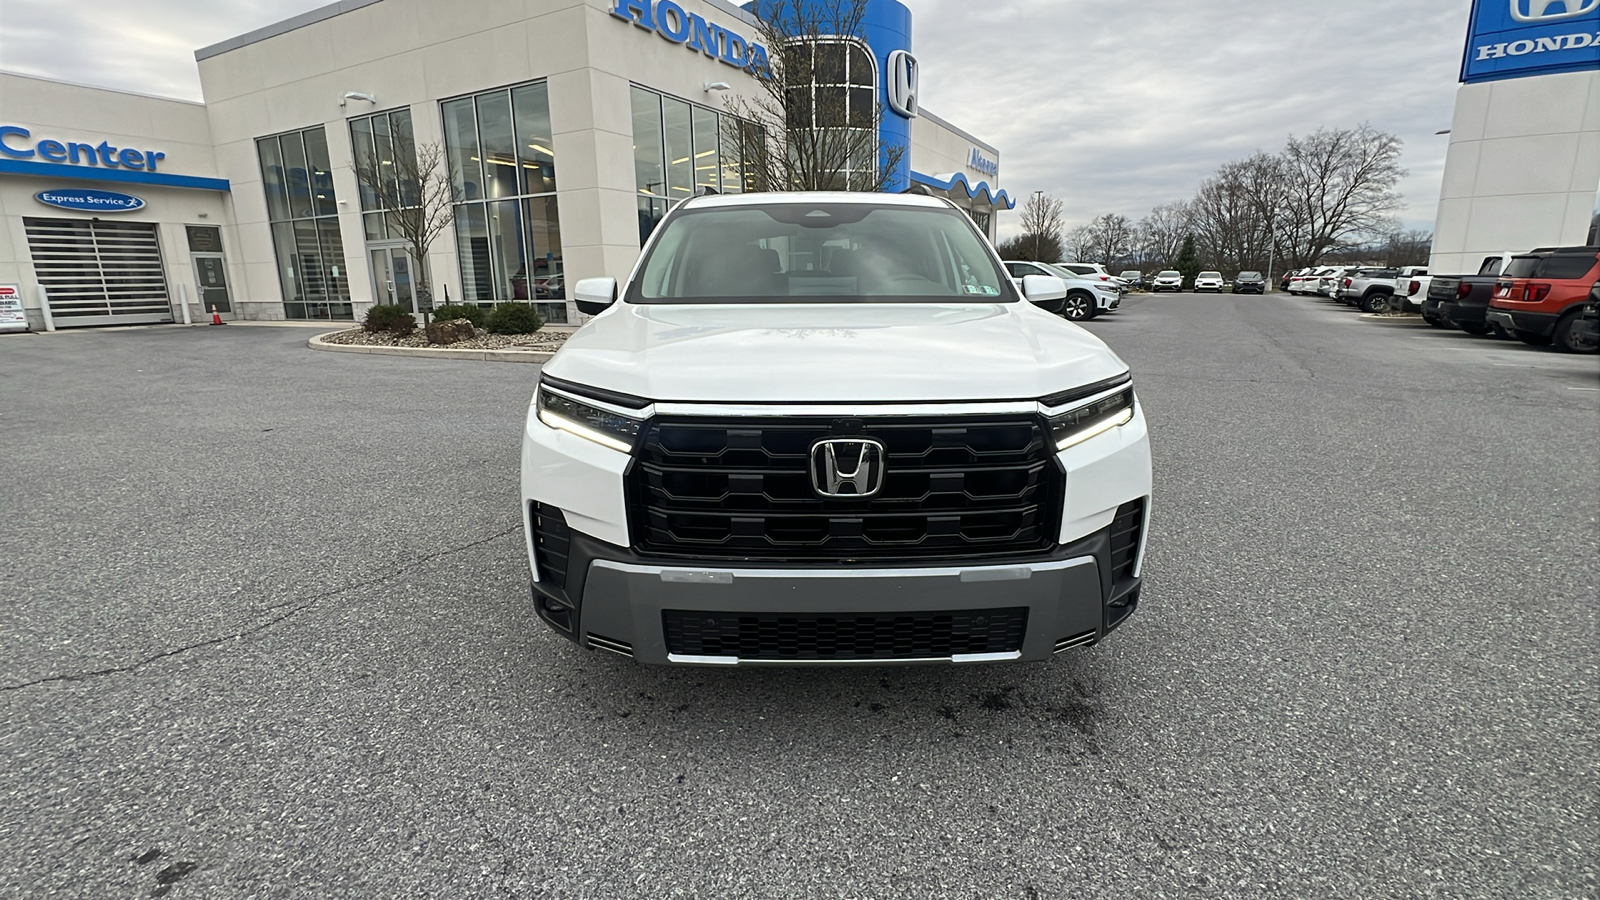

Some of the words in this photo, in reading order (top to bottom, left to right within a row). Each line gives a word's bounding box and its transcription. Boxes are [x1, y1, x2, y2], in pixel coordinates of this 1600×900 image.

[609, 0, 771, 80] HONDA
[0, 126, 165, 170] Center
[42, 193, 84, 204] Express
[86, 196, 124, 206] Service
